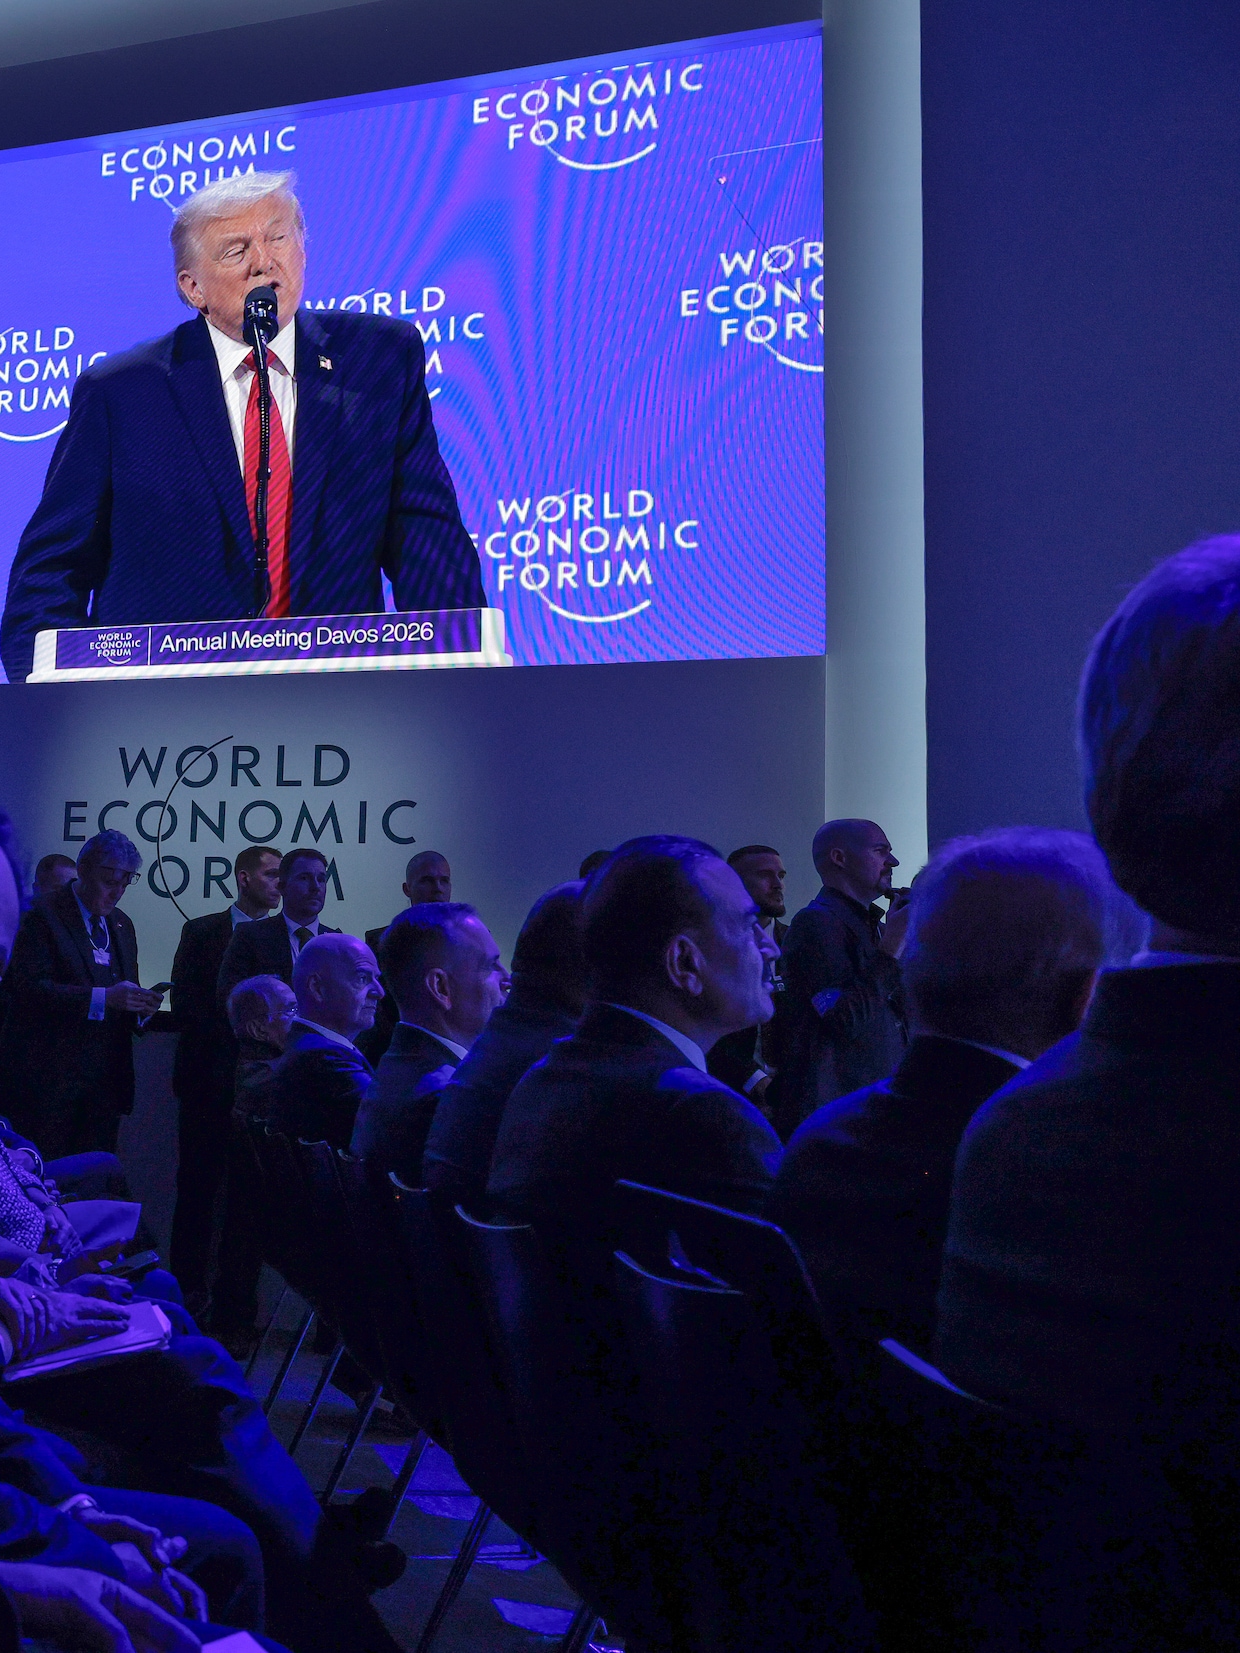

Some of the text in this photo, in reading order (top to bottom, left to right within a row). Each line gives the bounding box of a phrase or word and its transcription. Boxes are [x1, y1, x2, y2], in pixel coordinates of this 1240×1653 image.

[472, 63, 704, 124] ECONOMIC
[508, 103, 658, 150] FORUM
[101, 125, 297, 177] ECONOMIC
[720, 309, 824, 347] FOR
[497, 489, 655, 525] WORLD
[497, 557, 653, 592] FORUM
[89, 639, 141, 650] ECONOMIC
[97, 632, 133, 641] WORLD
[97, 648, 132, 657] FORUM
[159, 621, 434, 653] Annual Meeting Davos 2026
[118, 744, 351, 788] WORLD
[63, 799, 418, 845] ECONOMIC
